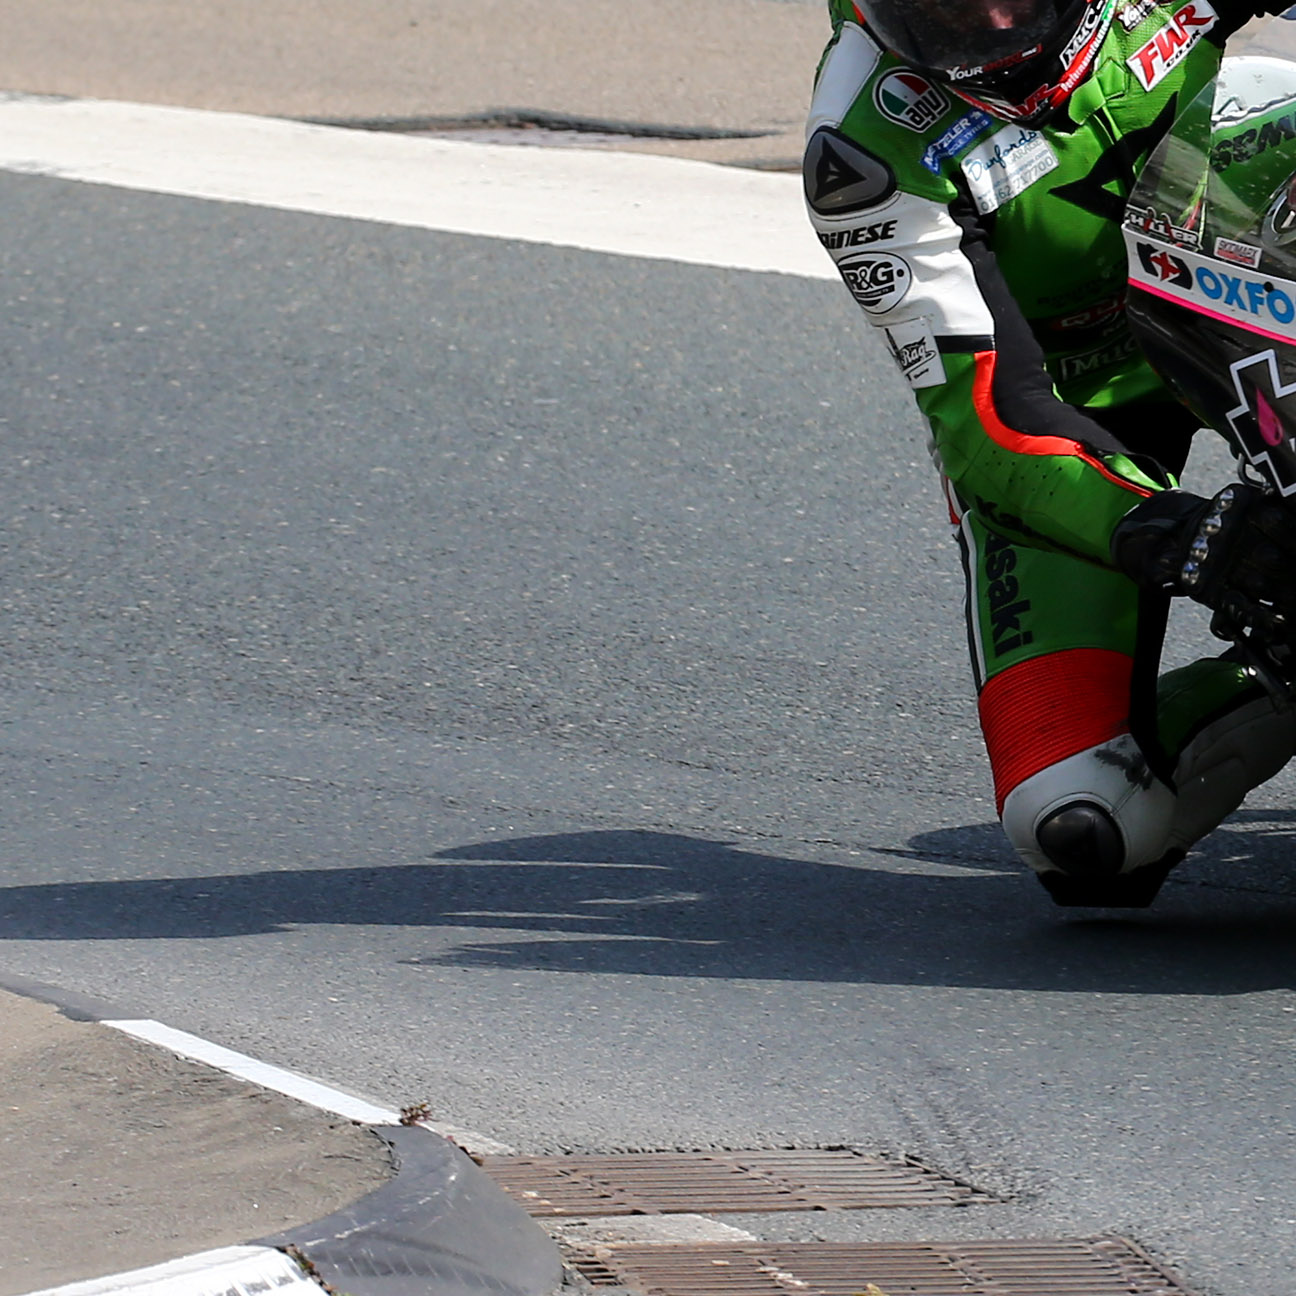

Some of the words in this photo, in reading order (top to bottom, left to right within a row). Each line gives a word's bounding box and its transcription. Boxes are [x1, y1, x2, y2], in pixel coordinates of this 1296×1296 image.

[1130, 5, 1214, 88] FWR
[905, 89, 941, 129] agv
[845, 261, 895, 292] R&G
